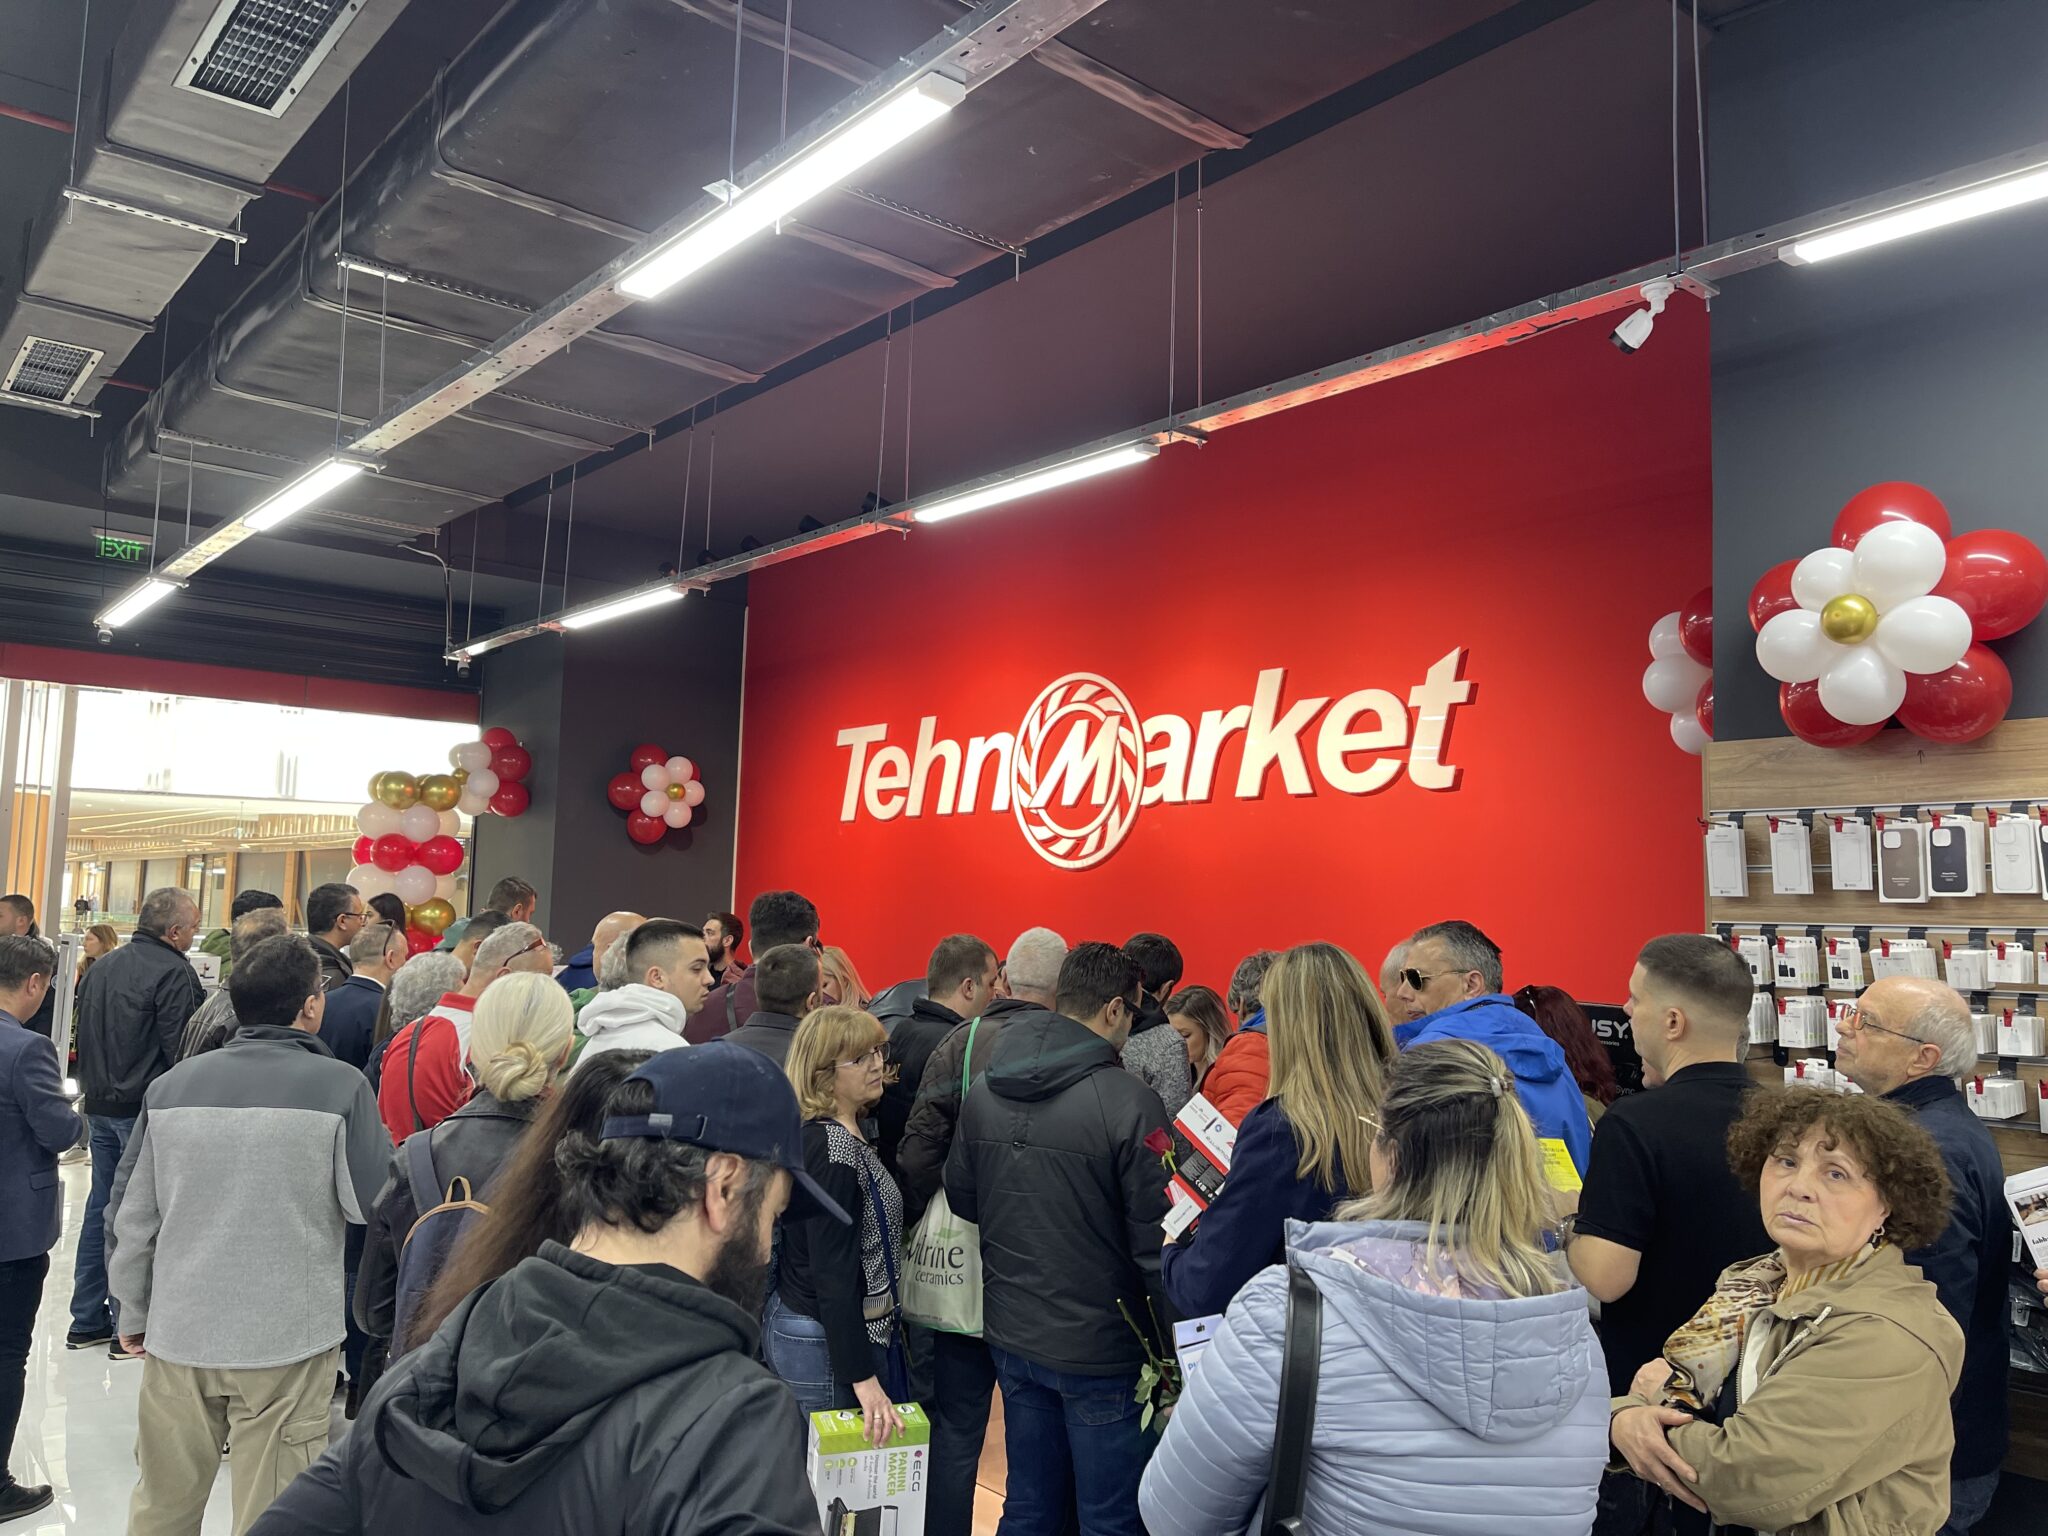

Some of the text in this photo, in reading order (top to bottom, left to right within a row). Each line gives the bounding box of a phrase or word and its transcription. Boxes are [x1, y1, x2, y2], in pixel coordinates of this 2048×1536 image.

[101, 541, 144, 561] EXIT
[915, 1271, 964, 1285] ceramics
[886, 1453, 898, 1497] MAKER
[897, 1451, 908, 1492] PANINI
[912, 1460, 921, 1492] ECG
